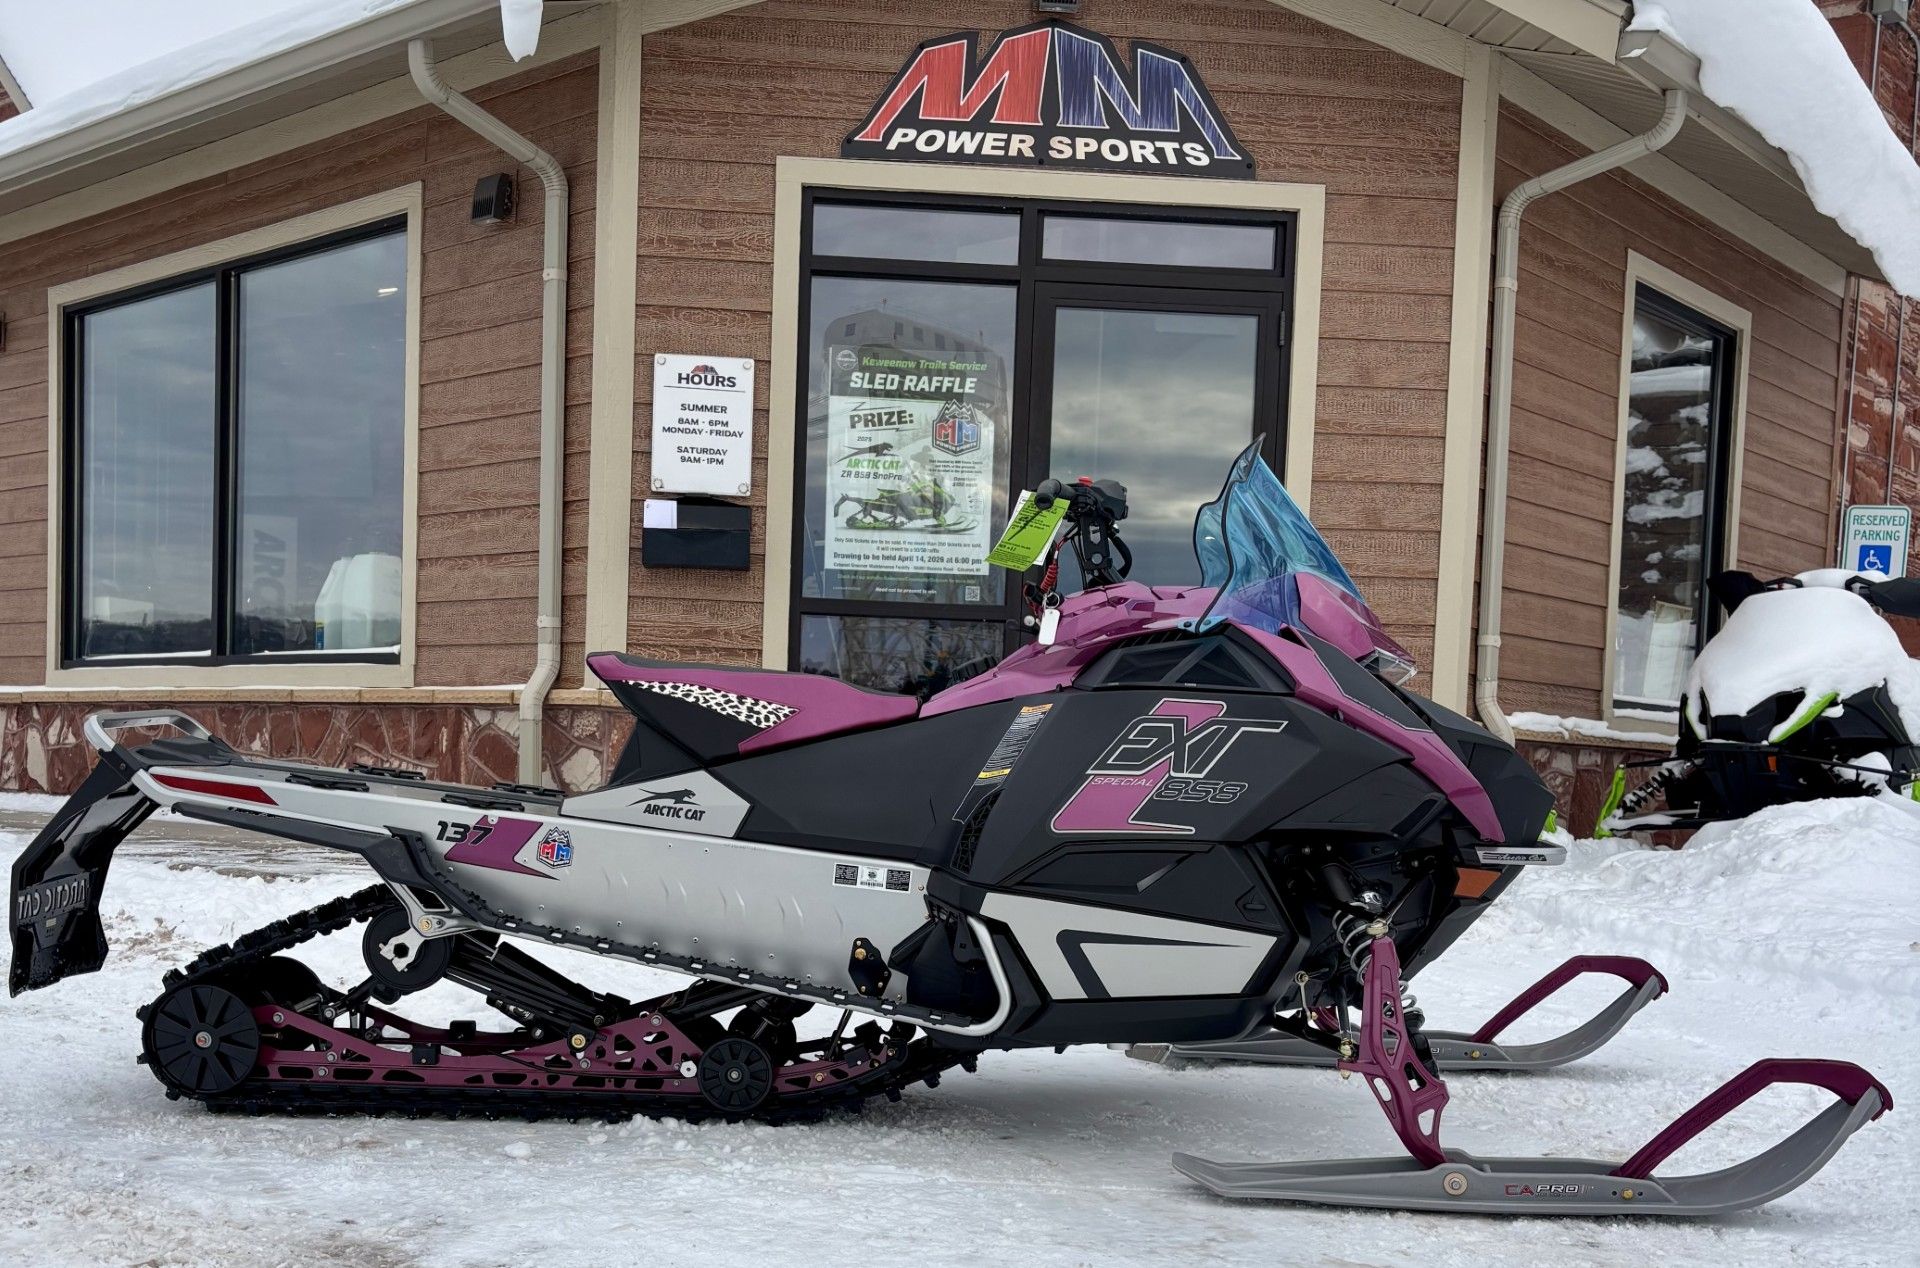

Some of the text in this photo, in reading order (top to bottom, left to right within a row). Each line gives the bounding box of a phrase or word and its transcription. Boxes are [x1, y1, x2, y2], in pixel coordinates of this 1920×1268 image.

[886, 128, 1211, 166] POWER SPORTS
[919, 360, 947, 370] Trails
[949, 360, 988, 372] Service
[677, 373, 737, 388] HOURS
[850, 372, 978, 394] SLED RAFFLE
[680, 404, 728, 414] SUMMER
[678, 417, 700, 426] 8AM
[708, 419, 729, 428] 6PM
[850, 410, 914, 429] PRIZE:
[662, 426, 704, 436] MONDAY
[709, 428, 744, 438] FRIDAY
[676, 446, 728, 456] SATURDAY
[680, 456, 701, 464] 9AM
[706, 457, 724, 465] 1PM
[847, 458, 901, 470] ARCTIC CAT
[872, 472, 903, 480] SnoPro
[1853, 515, 1905, 526] RESERVED
[1854, 530, 1900, 541] PARKING
[1085, 716, 1288, 778] EXT
[1090, 776, 1154, 788] SPECIAL
[1154, 779, 1248, 804] 858
[643, 804, 706, 822] ARCTIC CAT
[436, 820, 494, 846] 137
